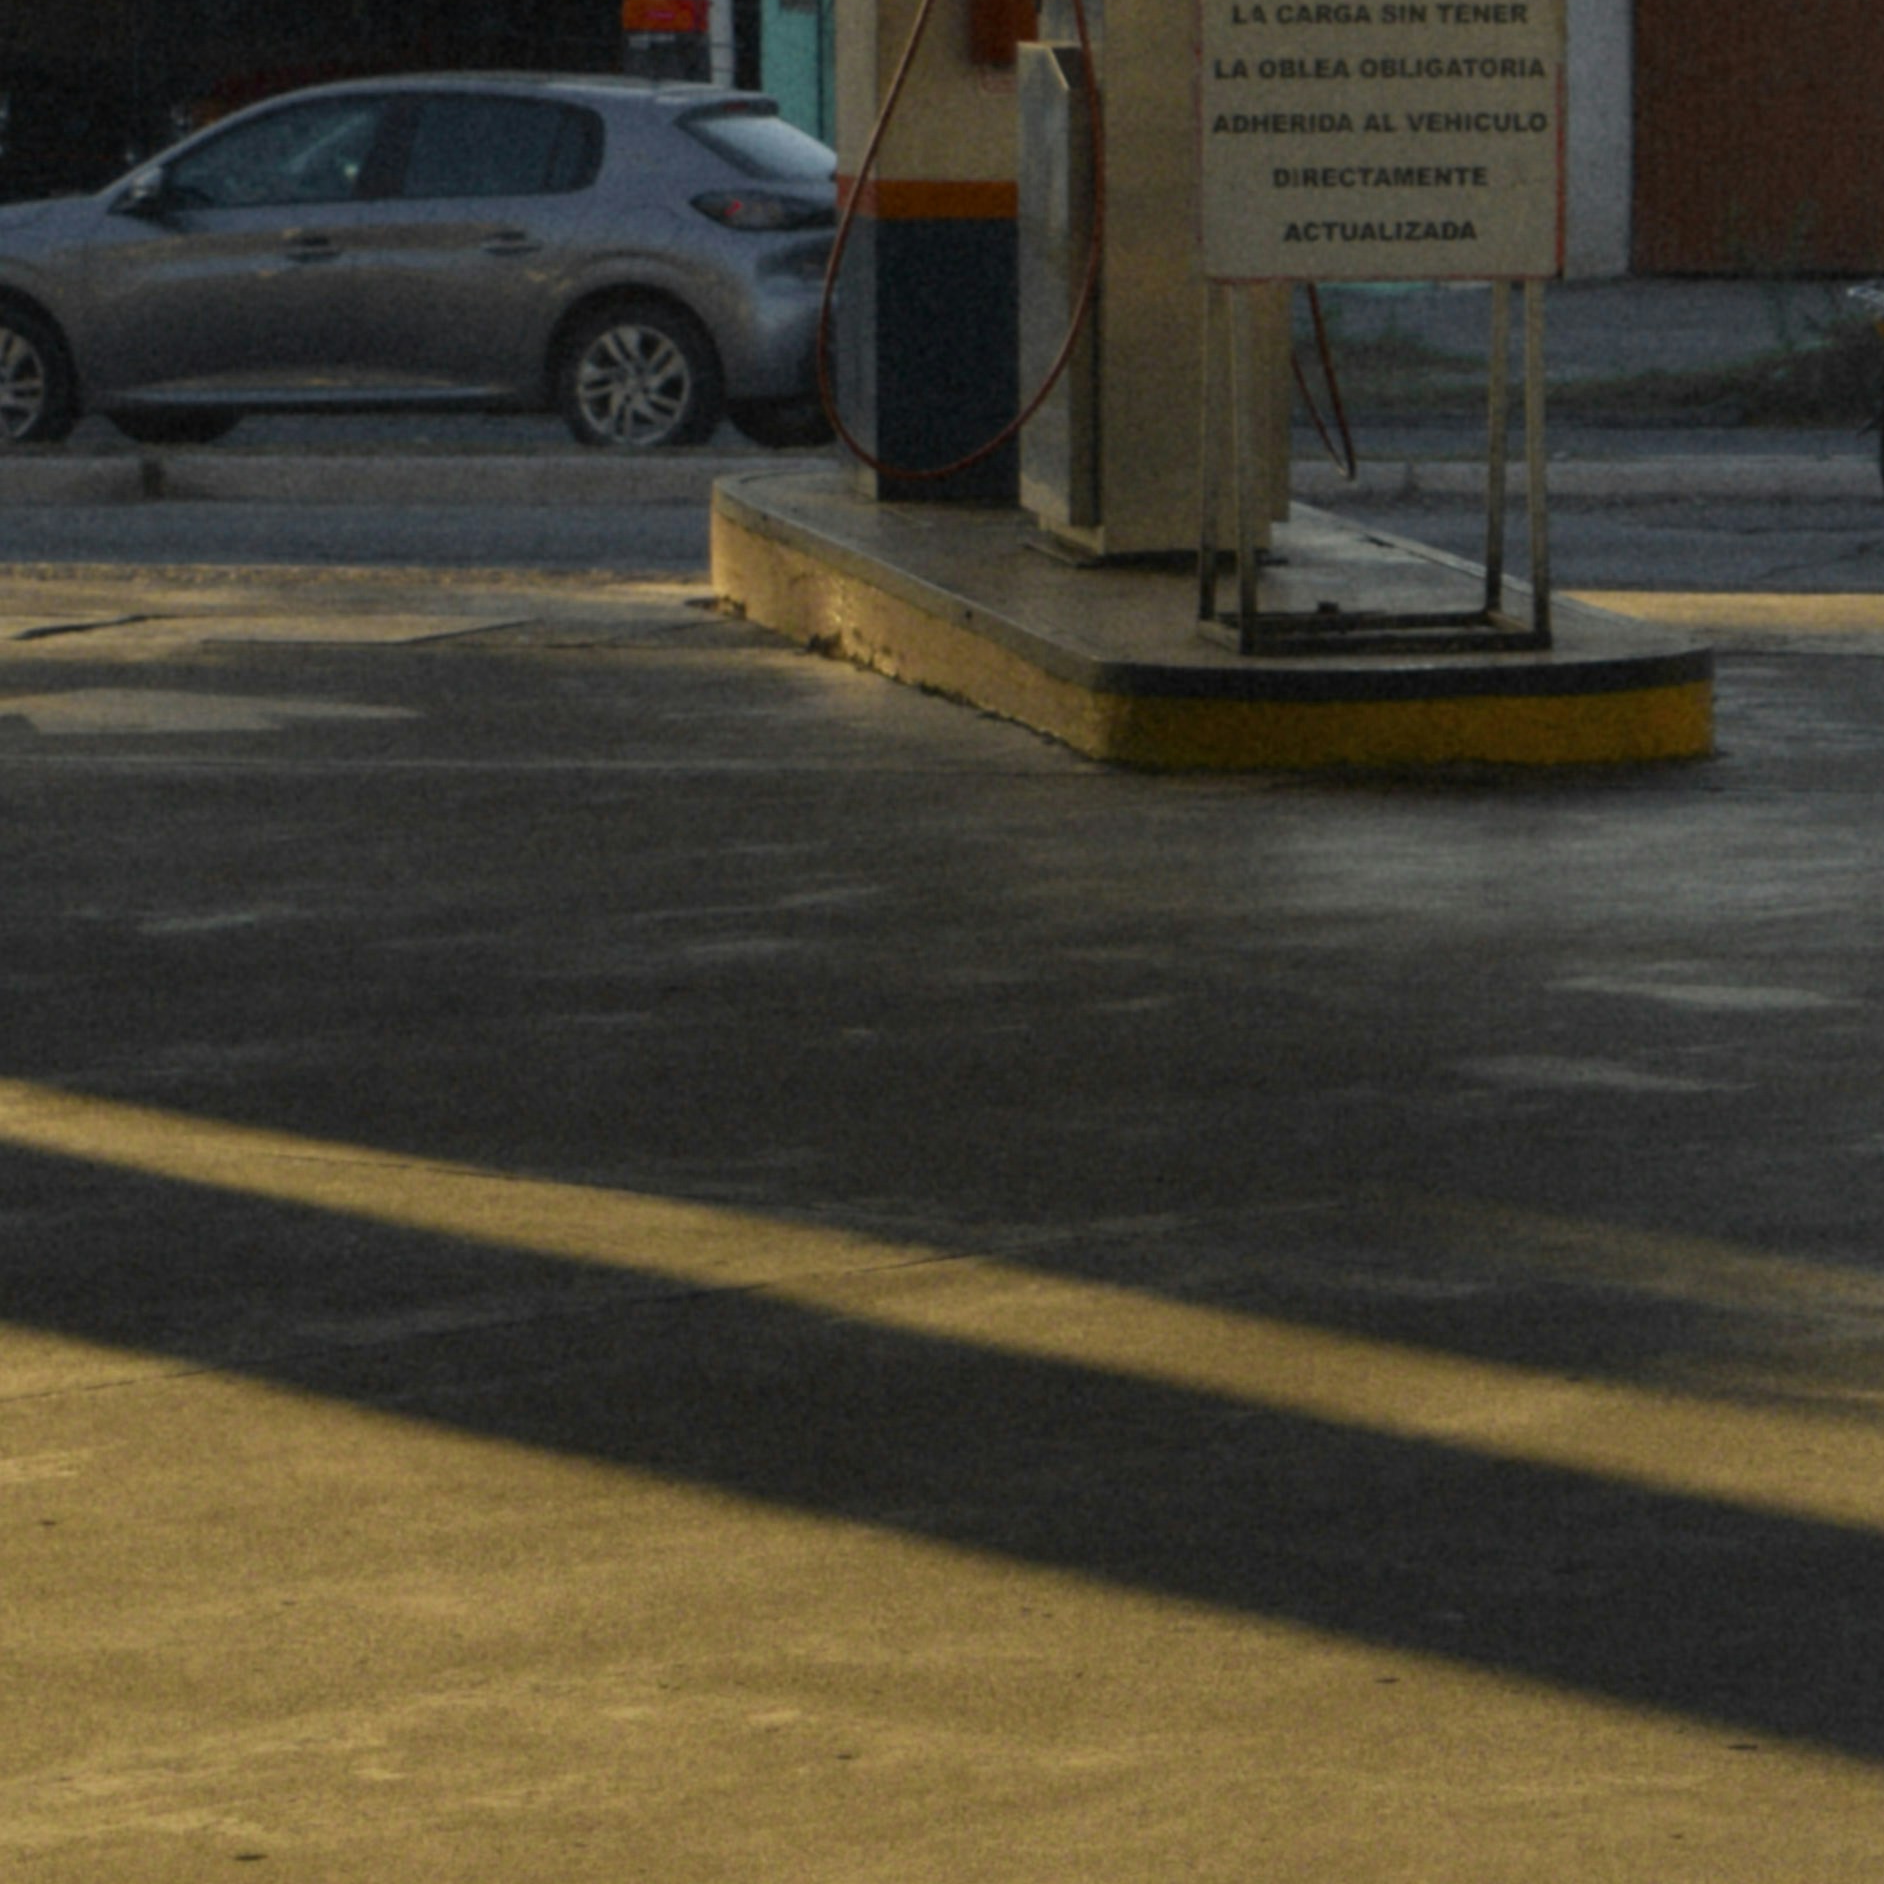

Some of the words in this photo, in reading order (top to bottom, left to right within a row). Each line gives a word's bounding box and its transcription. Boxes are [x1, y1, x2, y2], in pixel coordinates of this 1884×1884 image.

[1231, 4, 1267, 24] LA
[1276, 4, 1371, 24] CARGA
[1381, 4, 1427, 23] SIN
[1436, 3, 1528, 23] TENER
[1214, 59, 1248, 79] LA
[1258, 59, 1350, 78] OBLEA
[1359, 58, 1546, 78] OBLIGATORIA
[1213, 115, 1353, 134] ADHERIDA
[1363, 114, 1397, 133] AL
[1408, 113, 1548, 133] VEHICULO
[1272, 167, 1488, 188] DIRECTAMENTE
[1283, 221, 1477, 242] ACTUALIZADA
